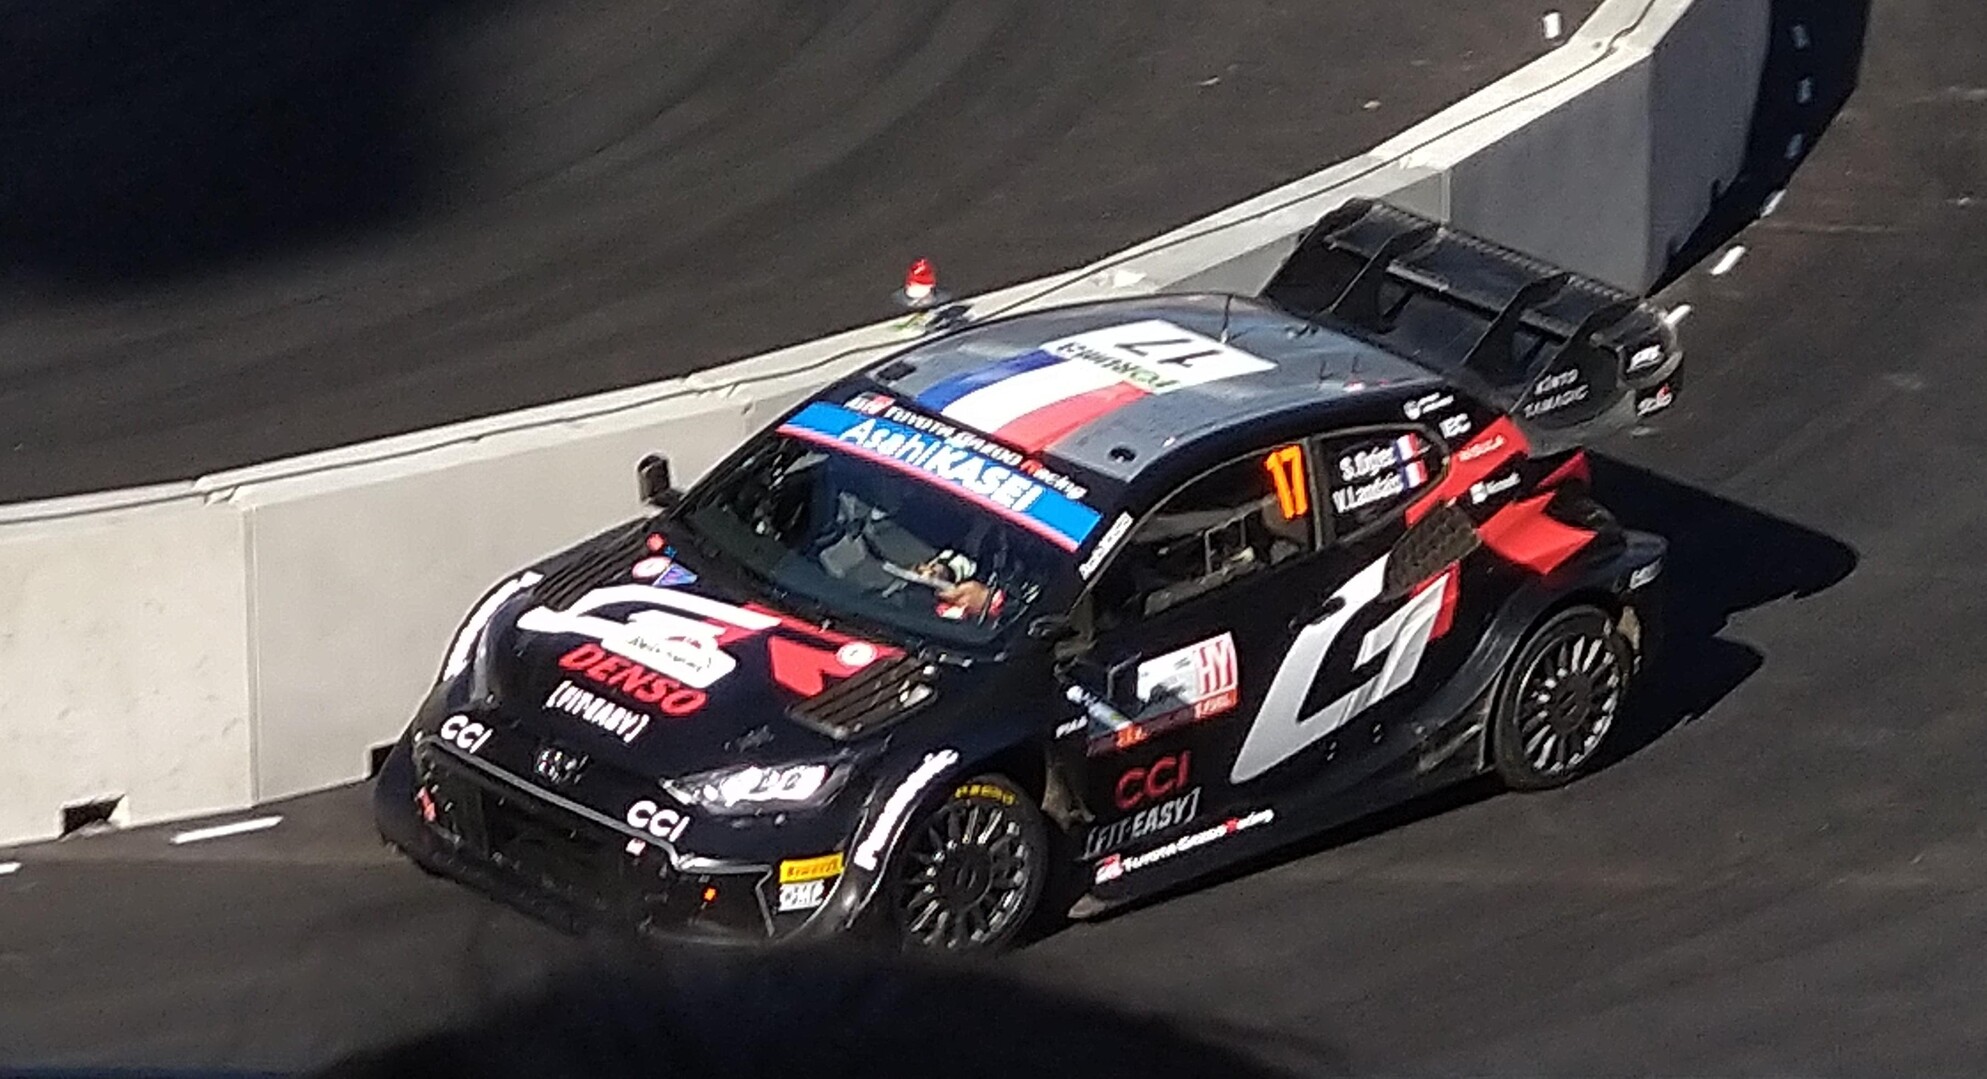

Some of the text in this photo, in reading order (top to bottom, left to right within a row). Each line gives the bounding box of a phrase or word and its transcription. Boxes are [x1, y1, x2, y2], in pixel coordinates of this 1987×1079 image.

[1114, 338, 1223, 367] 17
[838, 418, 1044, 513] AsahiKASEI
[1265, 445, 1308, 519] 17
[558, 642, 708, 717] DENSO
[440, 714, 493, 754] CCI
[1115, 750, 1190, 811] CCI
[626, 800, 691, 843] CCI
